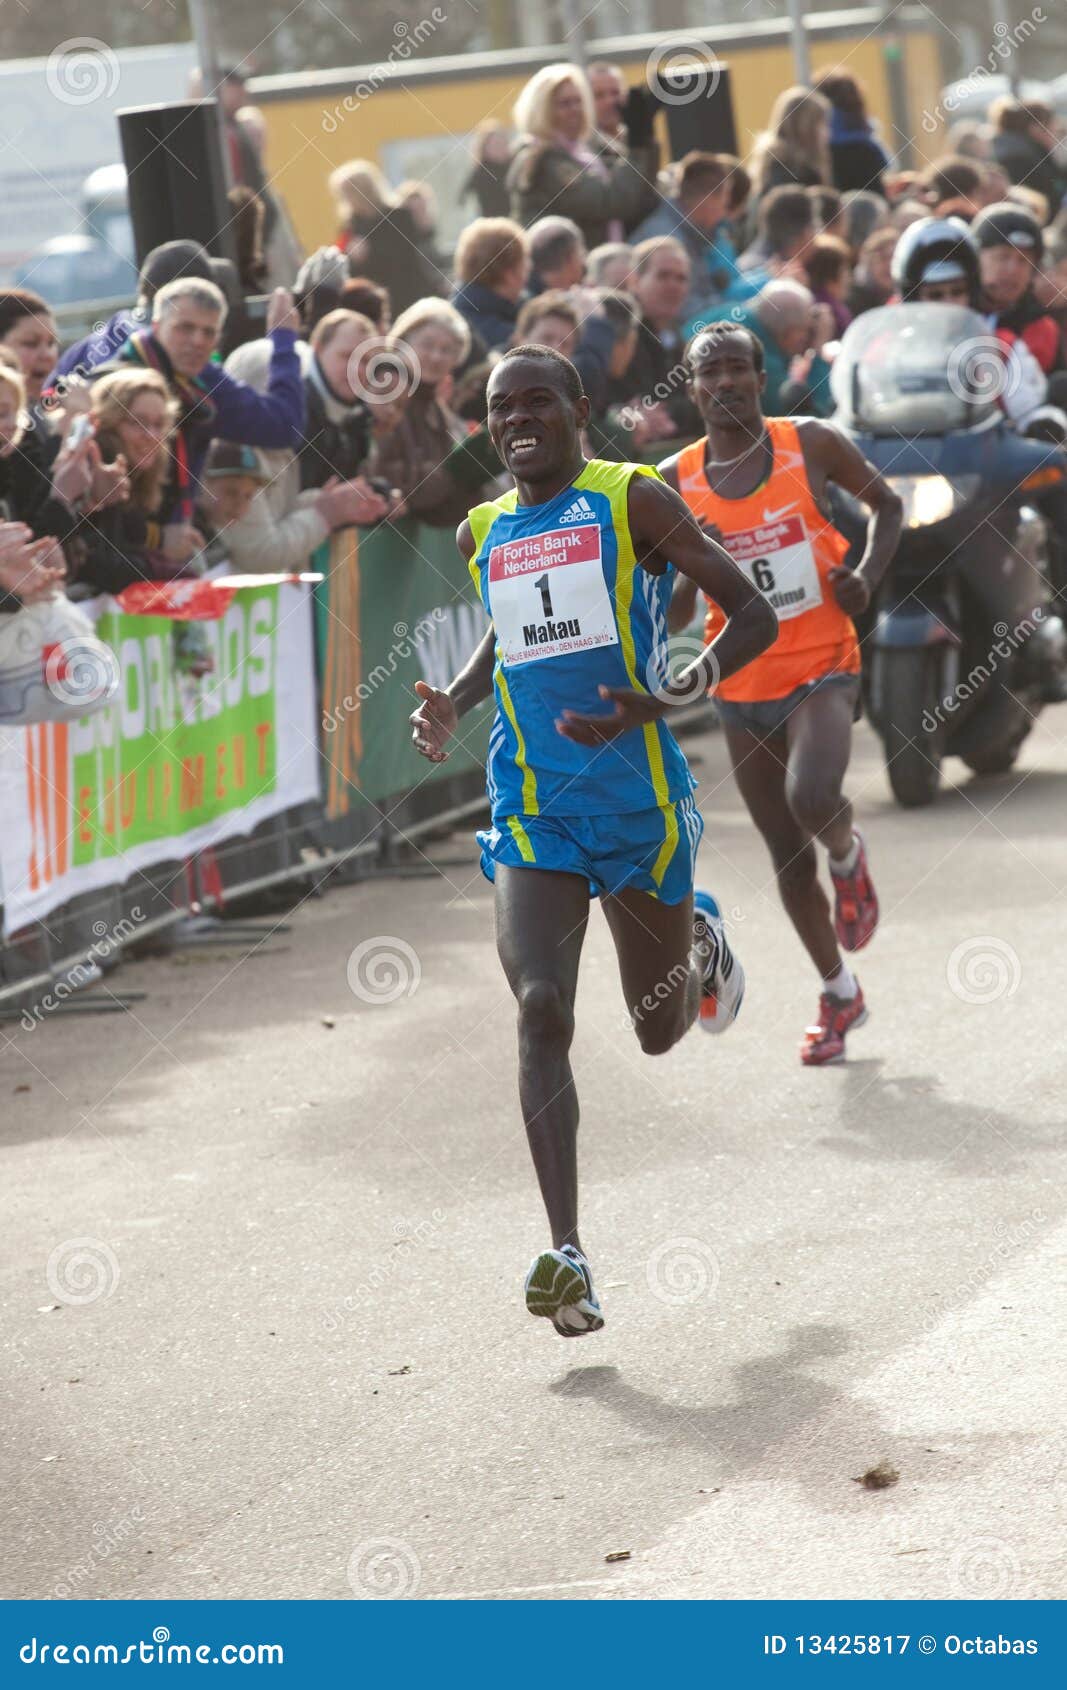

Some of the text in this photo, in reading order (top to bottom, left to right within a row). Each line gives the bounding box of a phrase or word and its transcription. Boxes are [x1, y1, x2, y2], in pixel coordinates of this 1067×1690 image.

[559, 511, 596, 524] adidas
[503, 531, 582, 561] Fortis Bank
[503, 549, 568, 576] Nederland
[751, 558, 775, 592] 6
[534, 573, 554, 618] 1
[522, 619, 582, 647] Makau
[559, 641, 573, 652] DEN
[573, 637, 593, 649] HAAG
